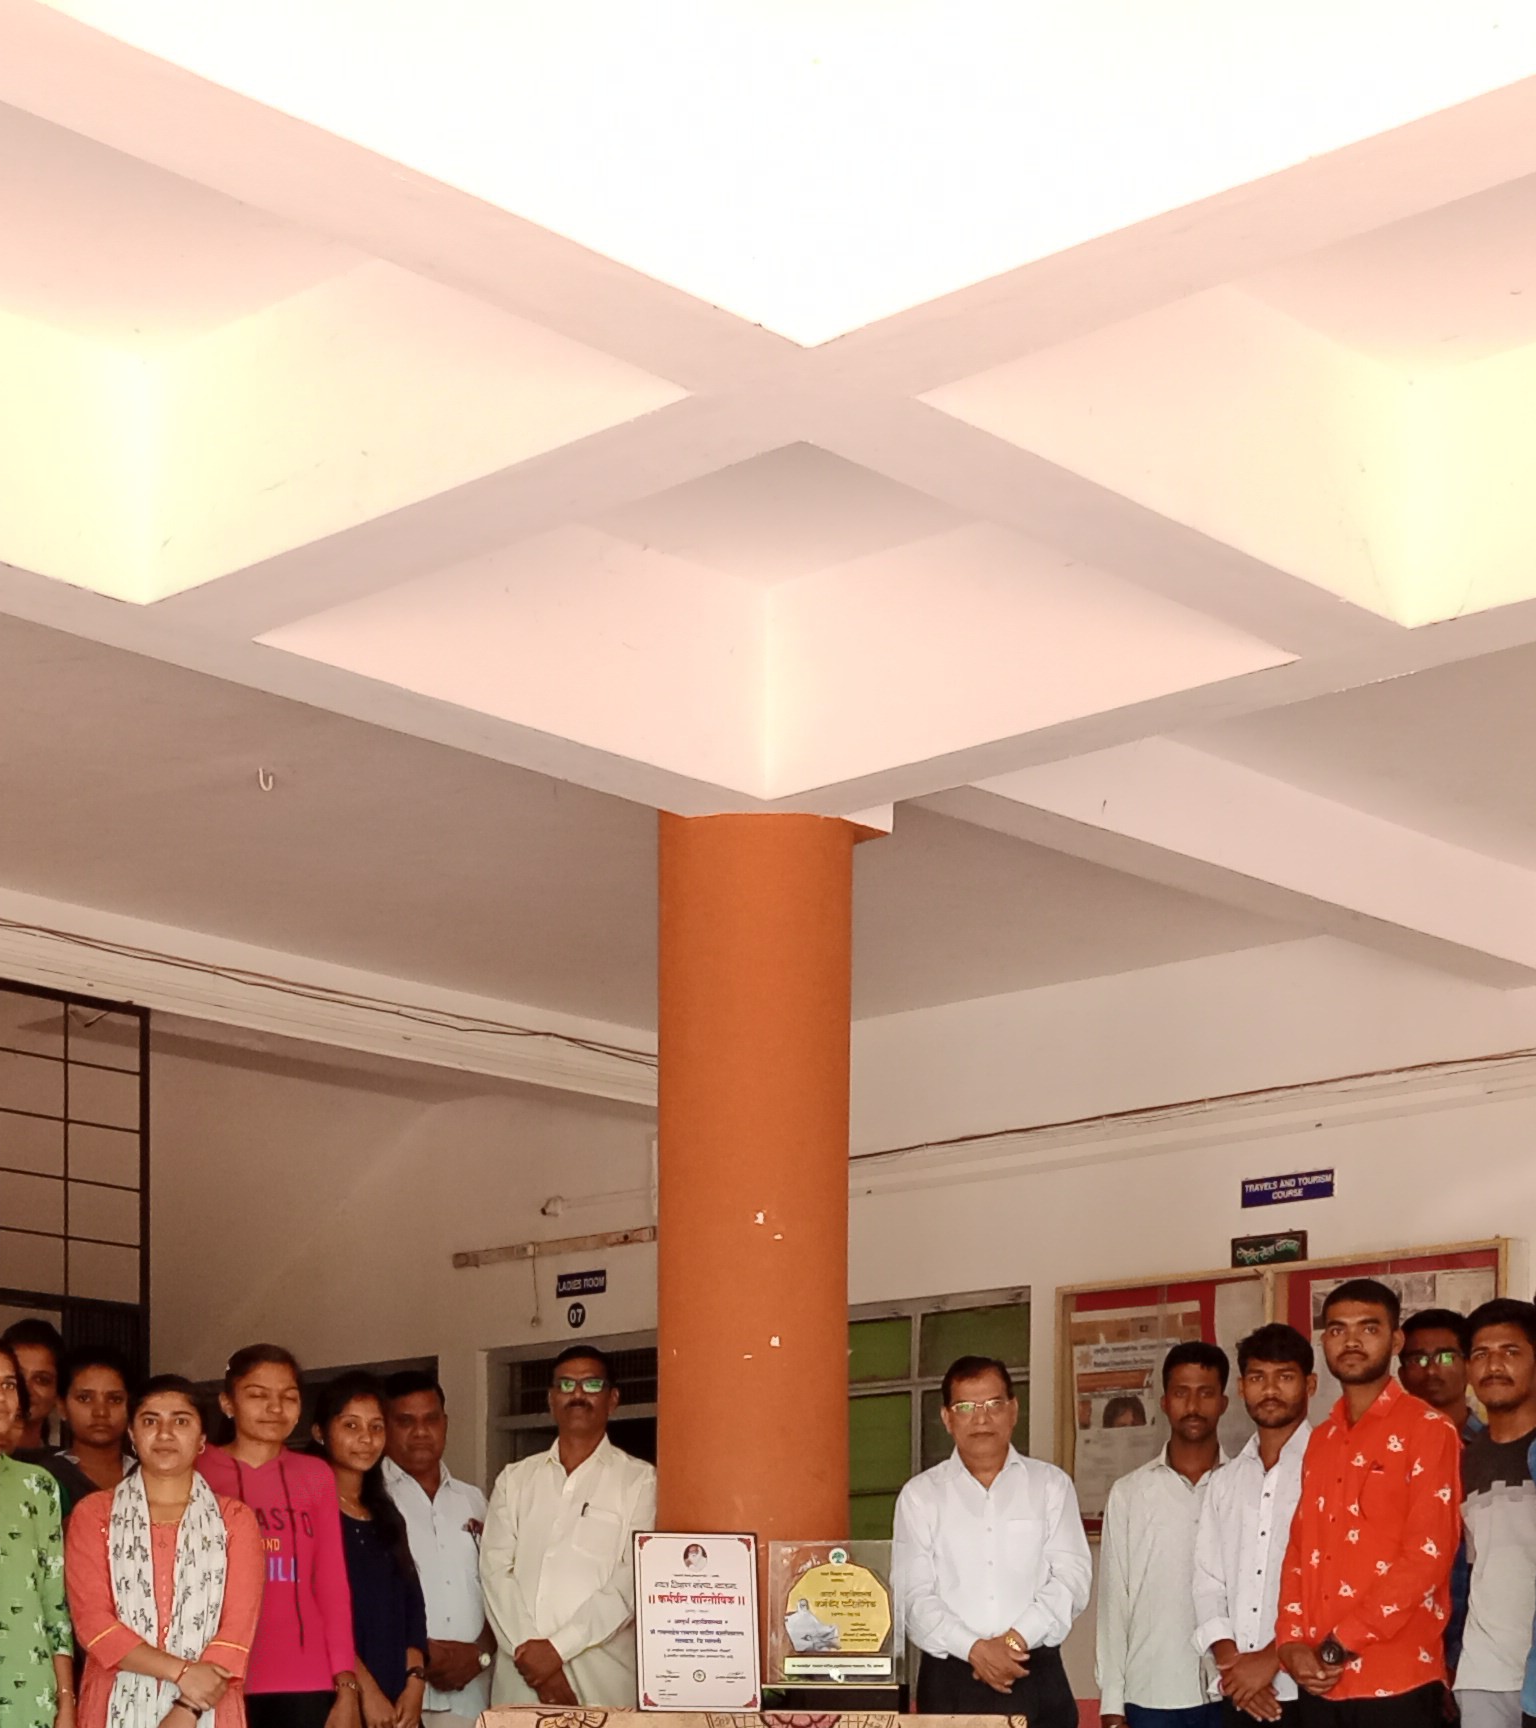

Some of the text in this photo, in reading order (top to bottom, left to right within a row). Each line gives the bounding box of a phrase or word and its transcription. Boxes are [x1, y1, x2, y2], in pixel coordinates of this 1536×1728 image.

[1245, 1173, 1332, 1193] TRAVELS AND TOURISM
[1272, 1188, 1304, 1200] COURSE
[558, 1276, 605, 1292] LADIES ROOM
[569, 1308, 583, 1324] 07
[269, 1556, 300, 1583] ILL
